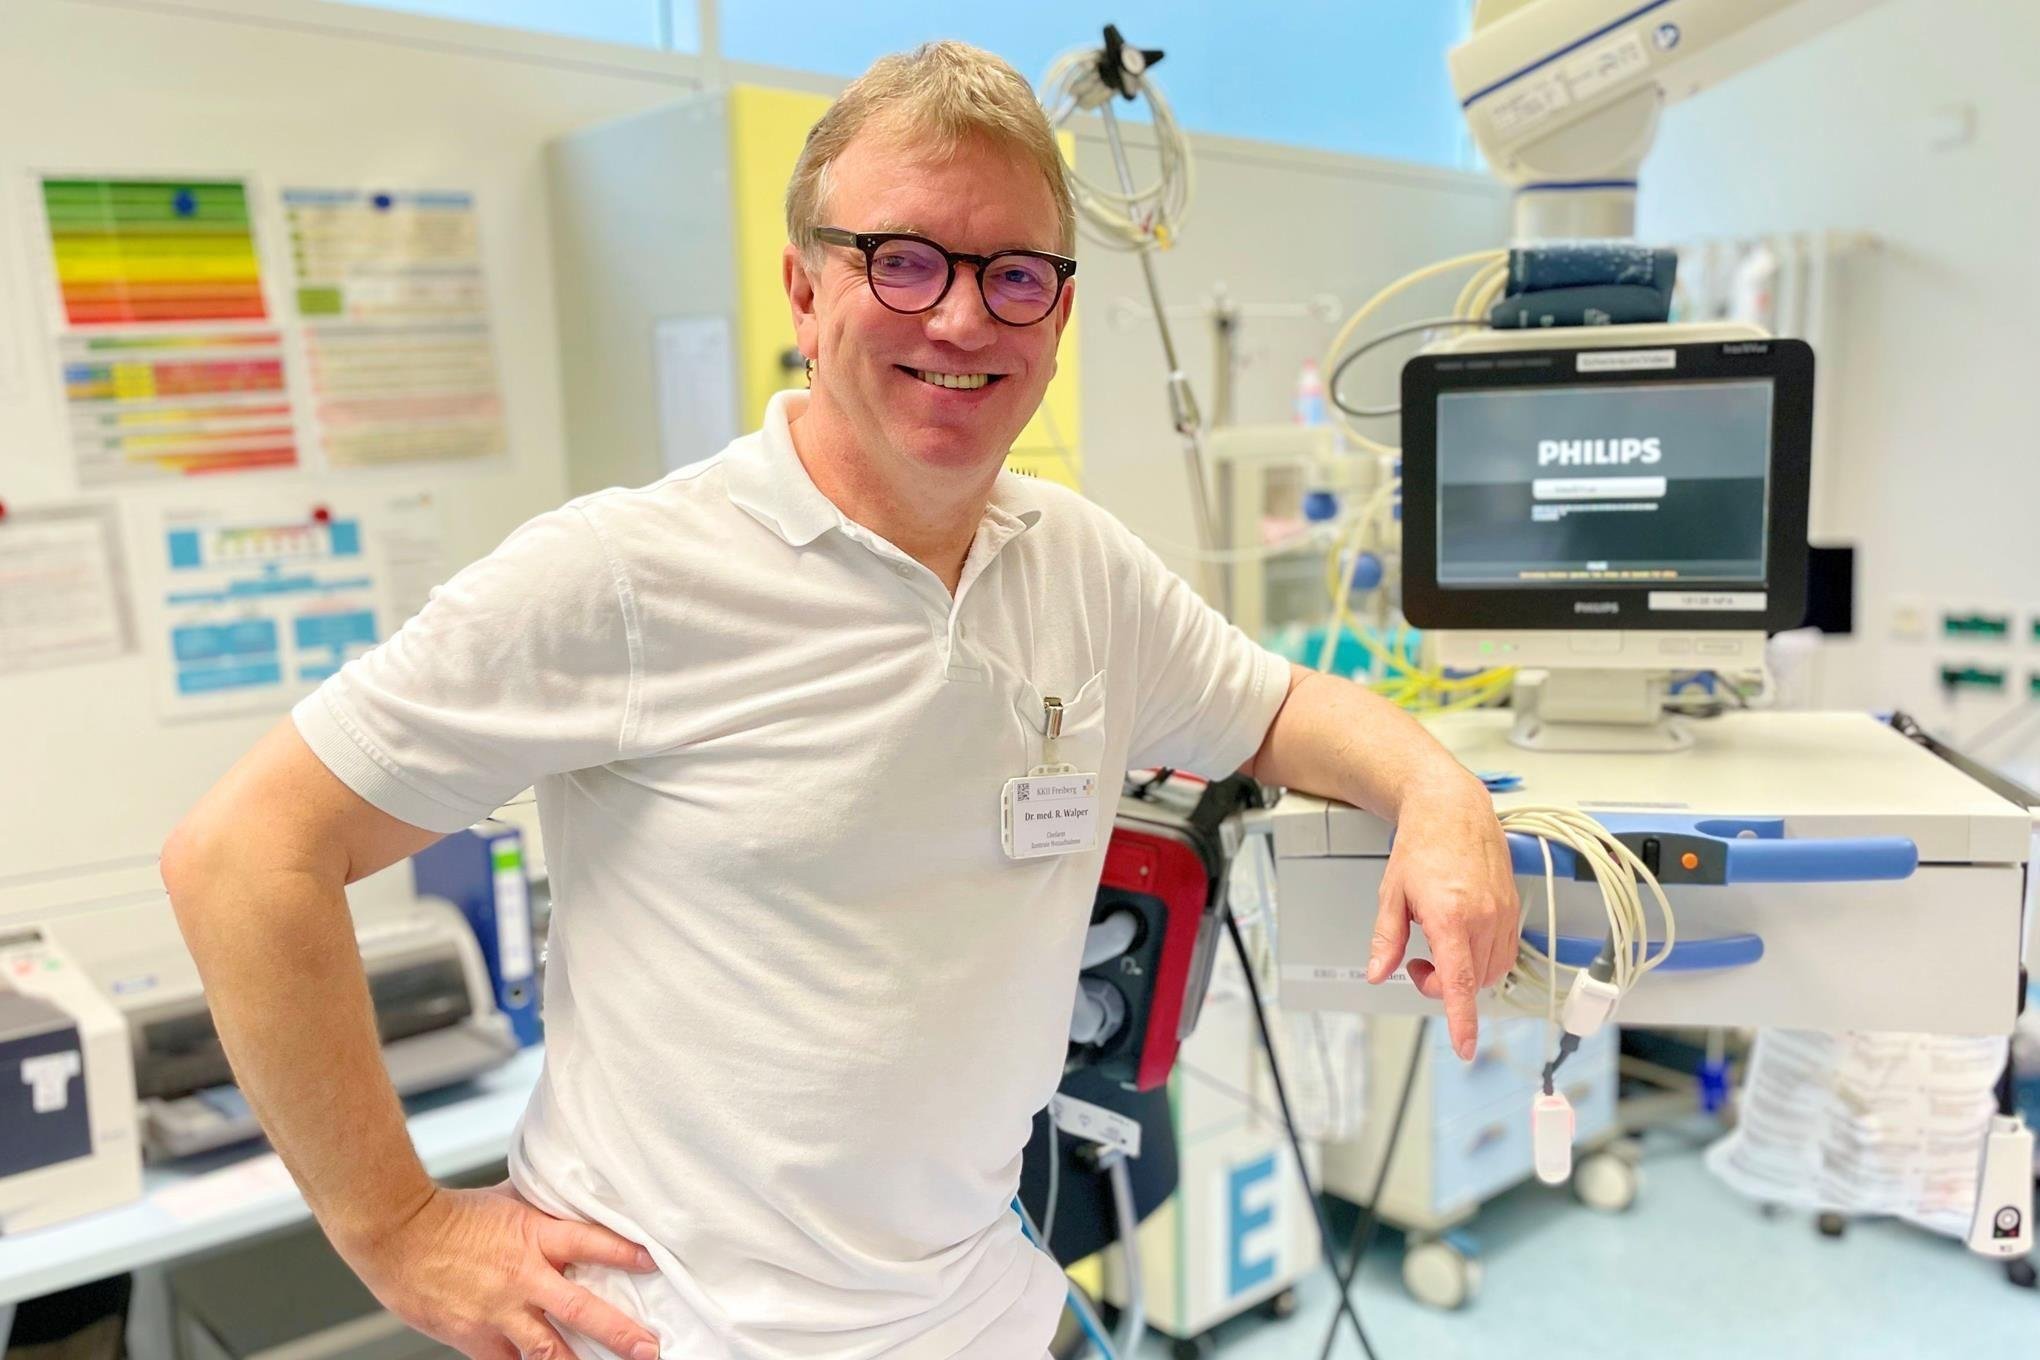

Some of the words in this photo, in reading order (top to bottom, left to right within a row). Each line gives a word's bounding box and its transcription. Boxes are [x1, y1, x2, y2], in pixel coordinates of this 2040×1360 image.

[1538, 437, 1662, 466] PHILIPS
[1052, 785, 1077, 795] Freiberg
[1025, 812, 1035, 821] Dr.
[1036, 810, 1053, 820] med.
[1063, 808, 1088, 819] Walper
[1228, 1153, 1277, 1297] E
